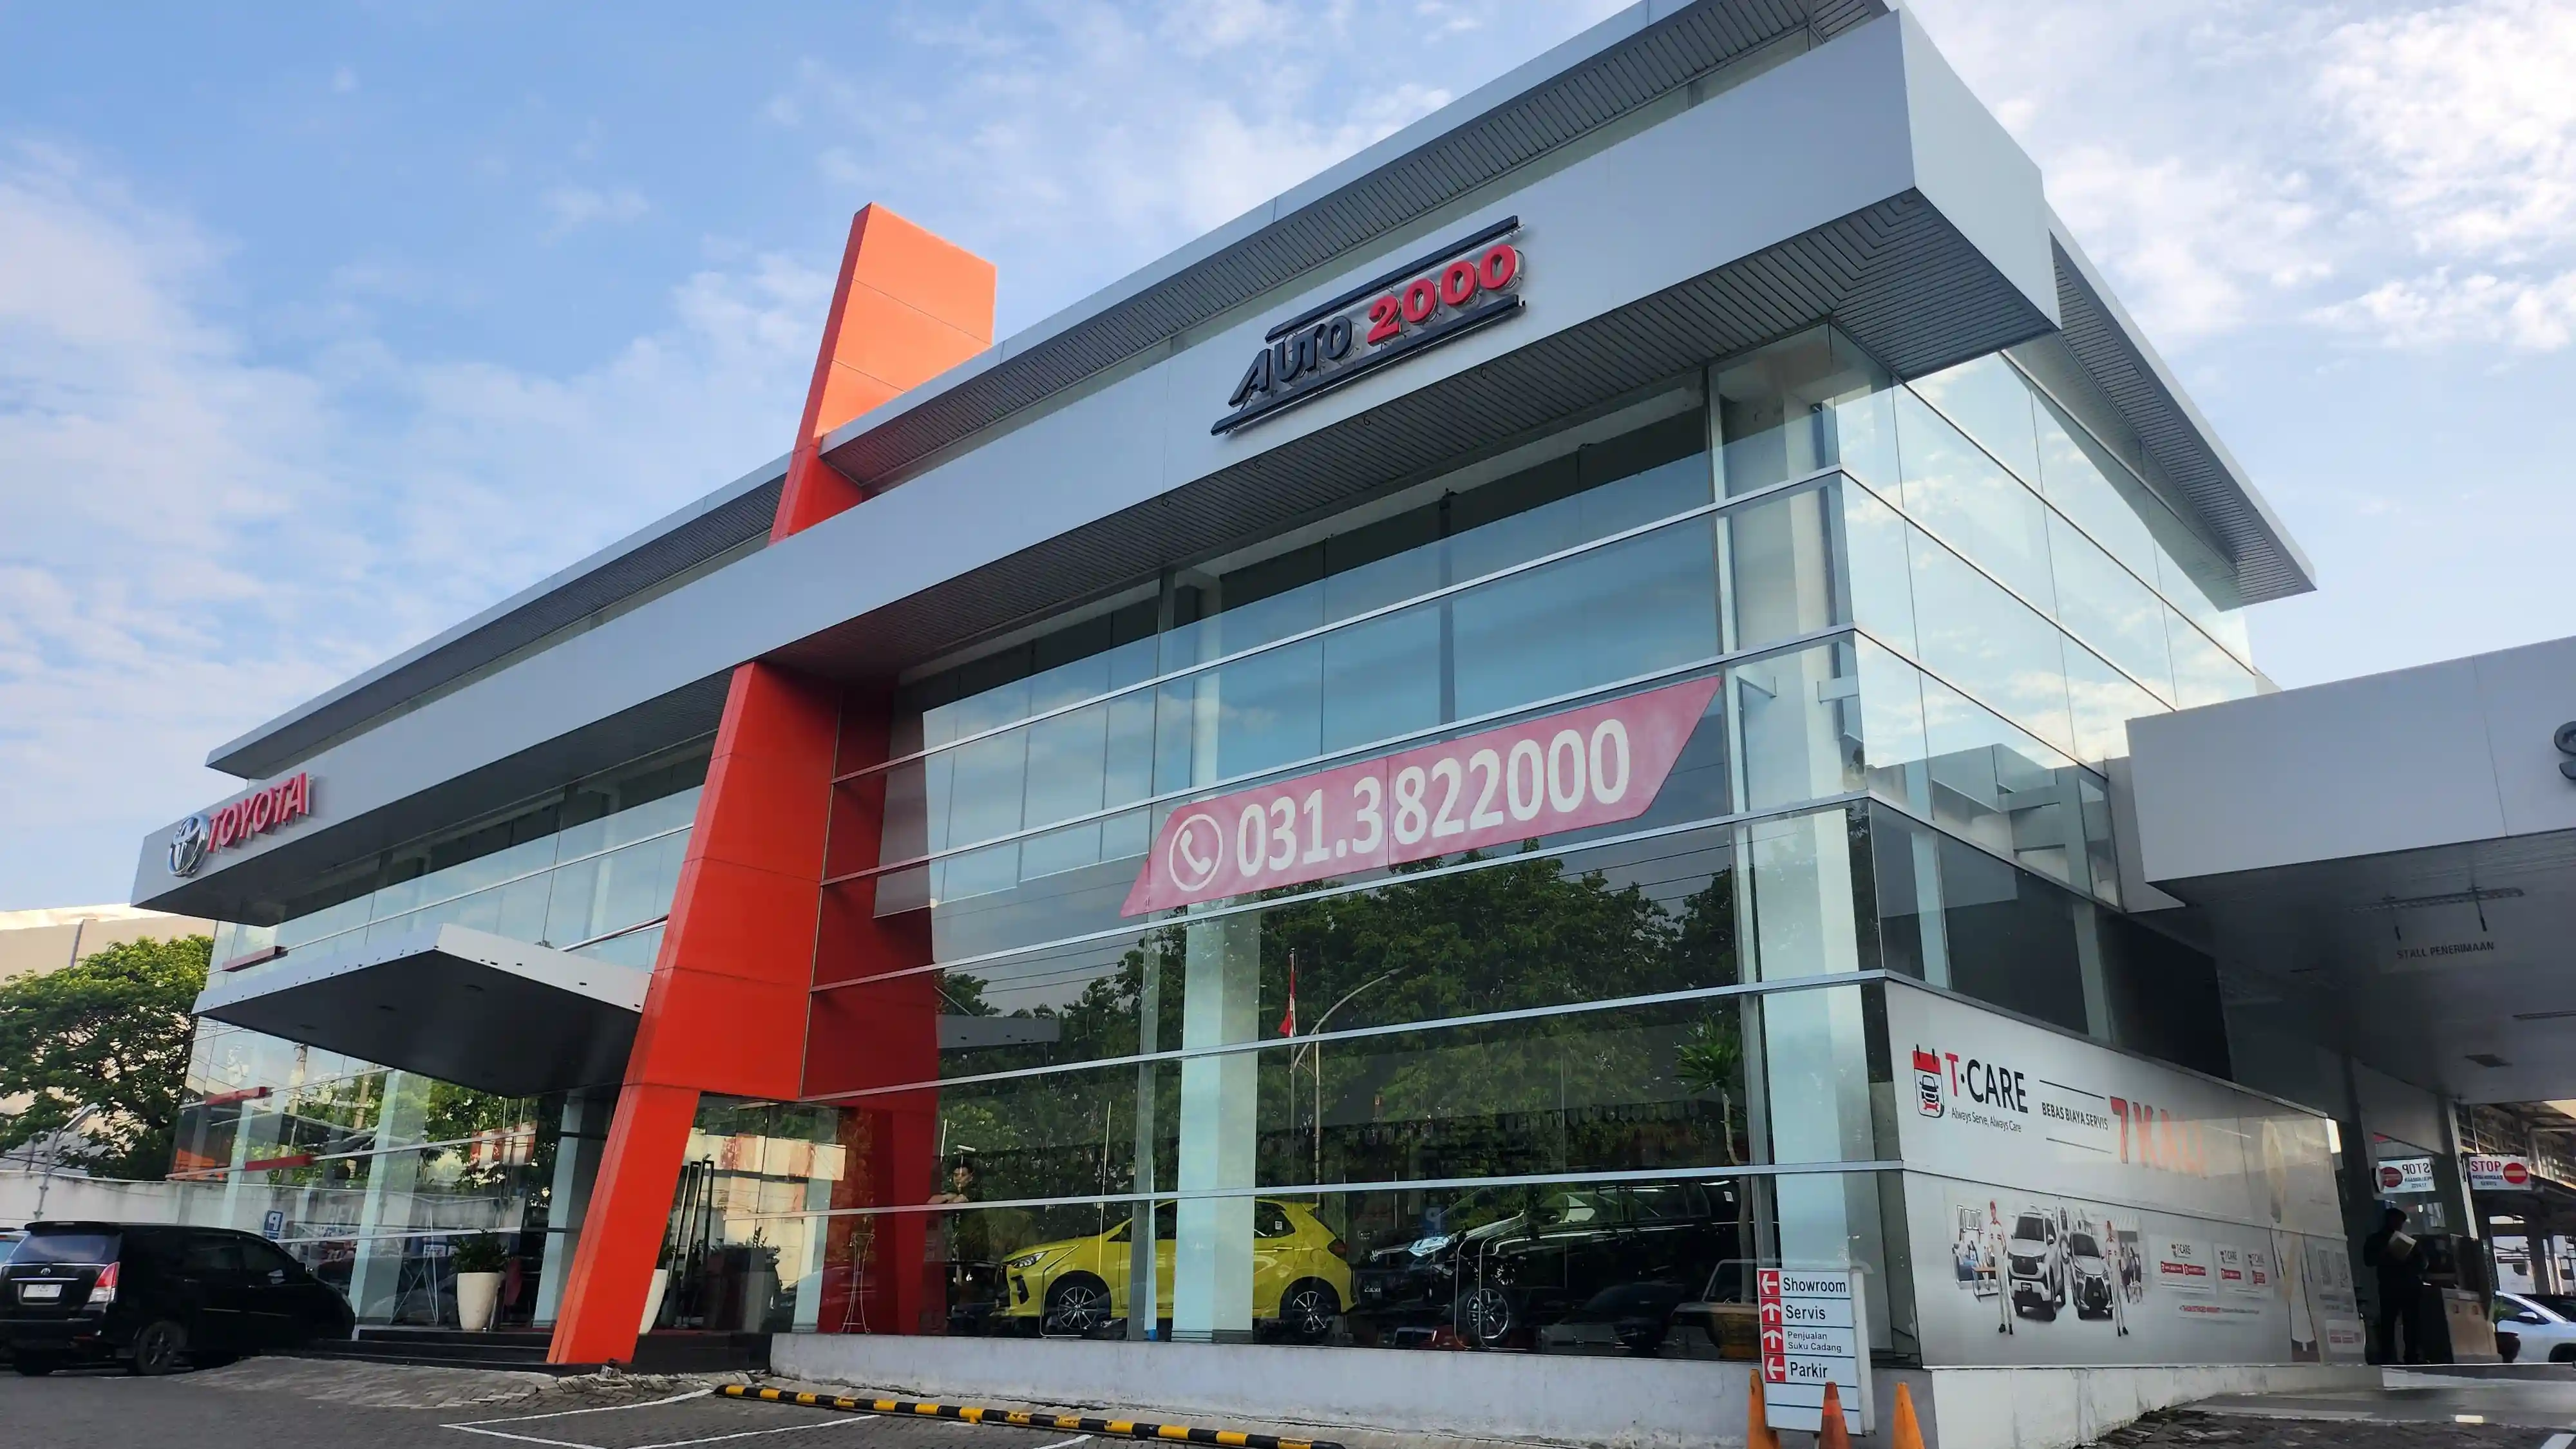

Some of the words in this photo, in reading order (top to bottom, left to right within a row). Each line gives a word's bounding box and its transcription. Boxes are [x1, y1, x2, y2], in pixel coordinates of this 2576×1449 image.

[1228, 316, 1353, 408] AUTO
[1368, 243, 1519, 346] 2000
[1236, 718, 1630, 878] 031.3822000
[207, 772, 309, 853] TOYOTA
[2396, 948, 2427, 960] STALL
[2430, 941, 2495, 956] PENERIMAAN
[1951, 1107, 1971, 1124] Always
[1990, 1115, 2009, 1132] Always
[2009, 1121, 2022, 1133] Care
[2041, 1102, 2065, 1120] BEBAS
[2065, 1108, 2086, 1126] BIAYA
[2086, 1113, 2108, 1130] SERVIS
[2471, 1160, 2501, 1171] STOP
[1783, 1277, 1846, 1293] Showroom
[1786, 1305, 1826, 1320] Servis
[1788, 1331, 1827, 1342] Penjualan
[1788, 1341, 1809, 1350] Suku
[1810, 1342, 1842, 1353] Cadang
[1790, 1361, 1828, 1378] Parkir
